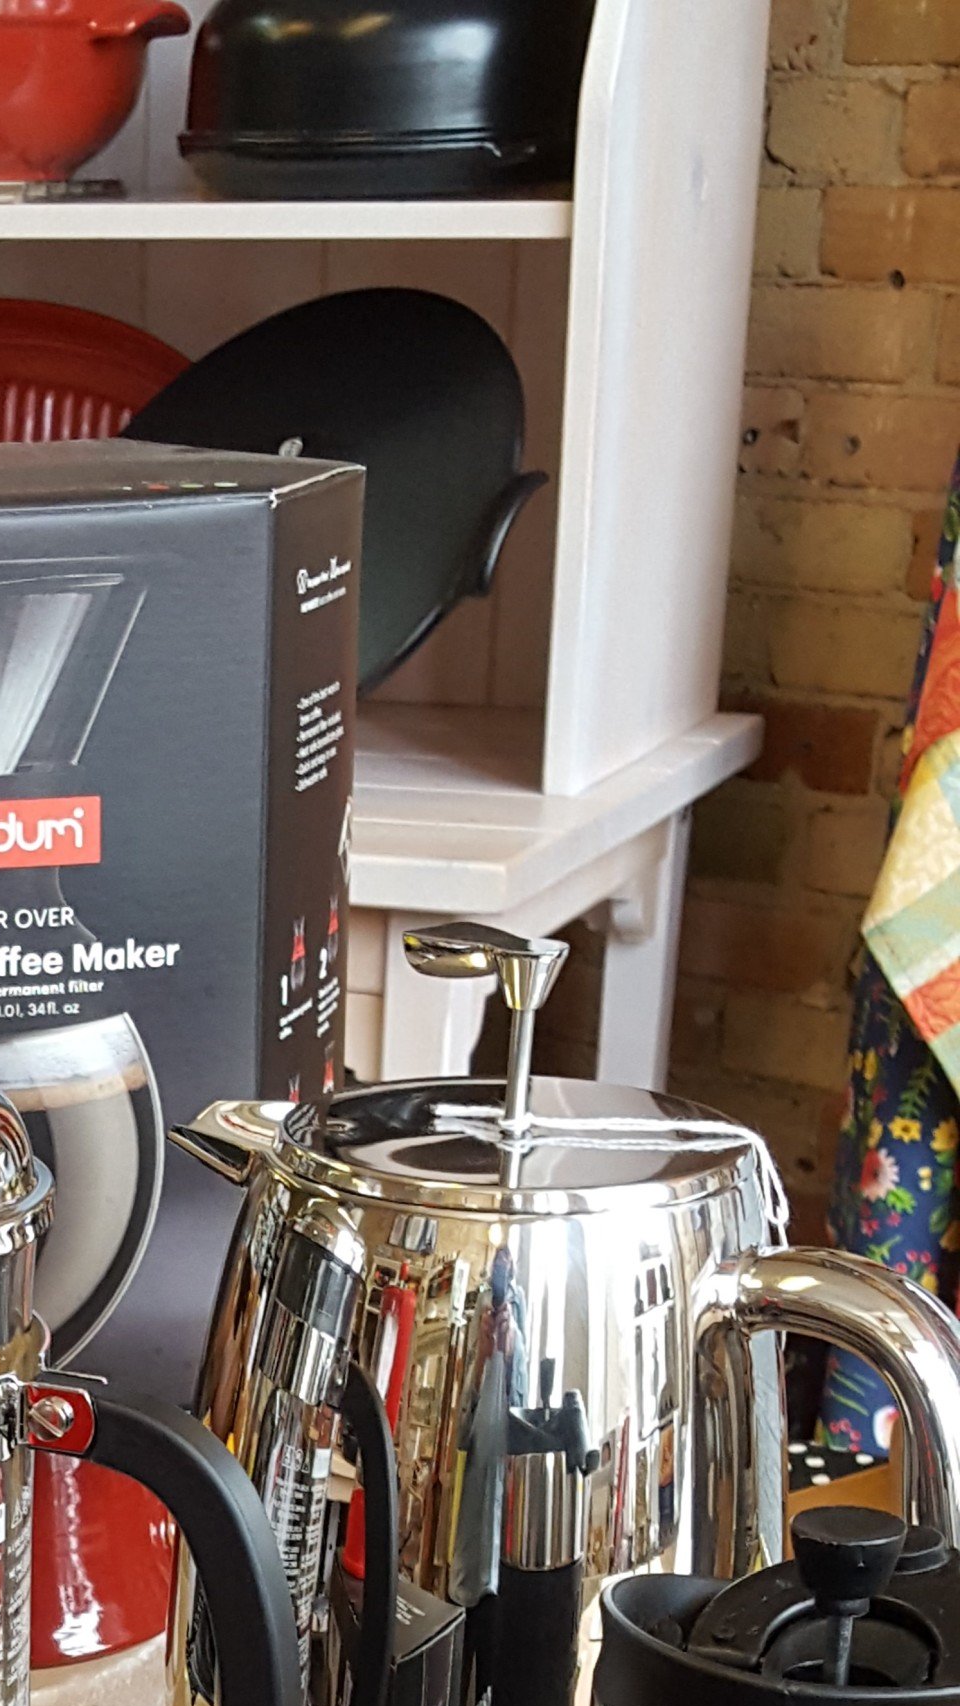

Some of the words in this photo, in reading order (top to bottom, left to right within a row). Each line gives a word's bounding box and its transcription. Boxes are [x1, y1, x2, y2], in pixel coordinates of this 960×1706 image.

[14, 906, 75, 929] OVER
[72, 938, 180, 973] Maker
[67, 978, 104, 994] filter
[62, 1002, 80, 1015] oz
